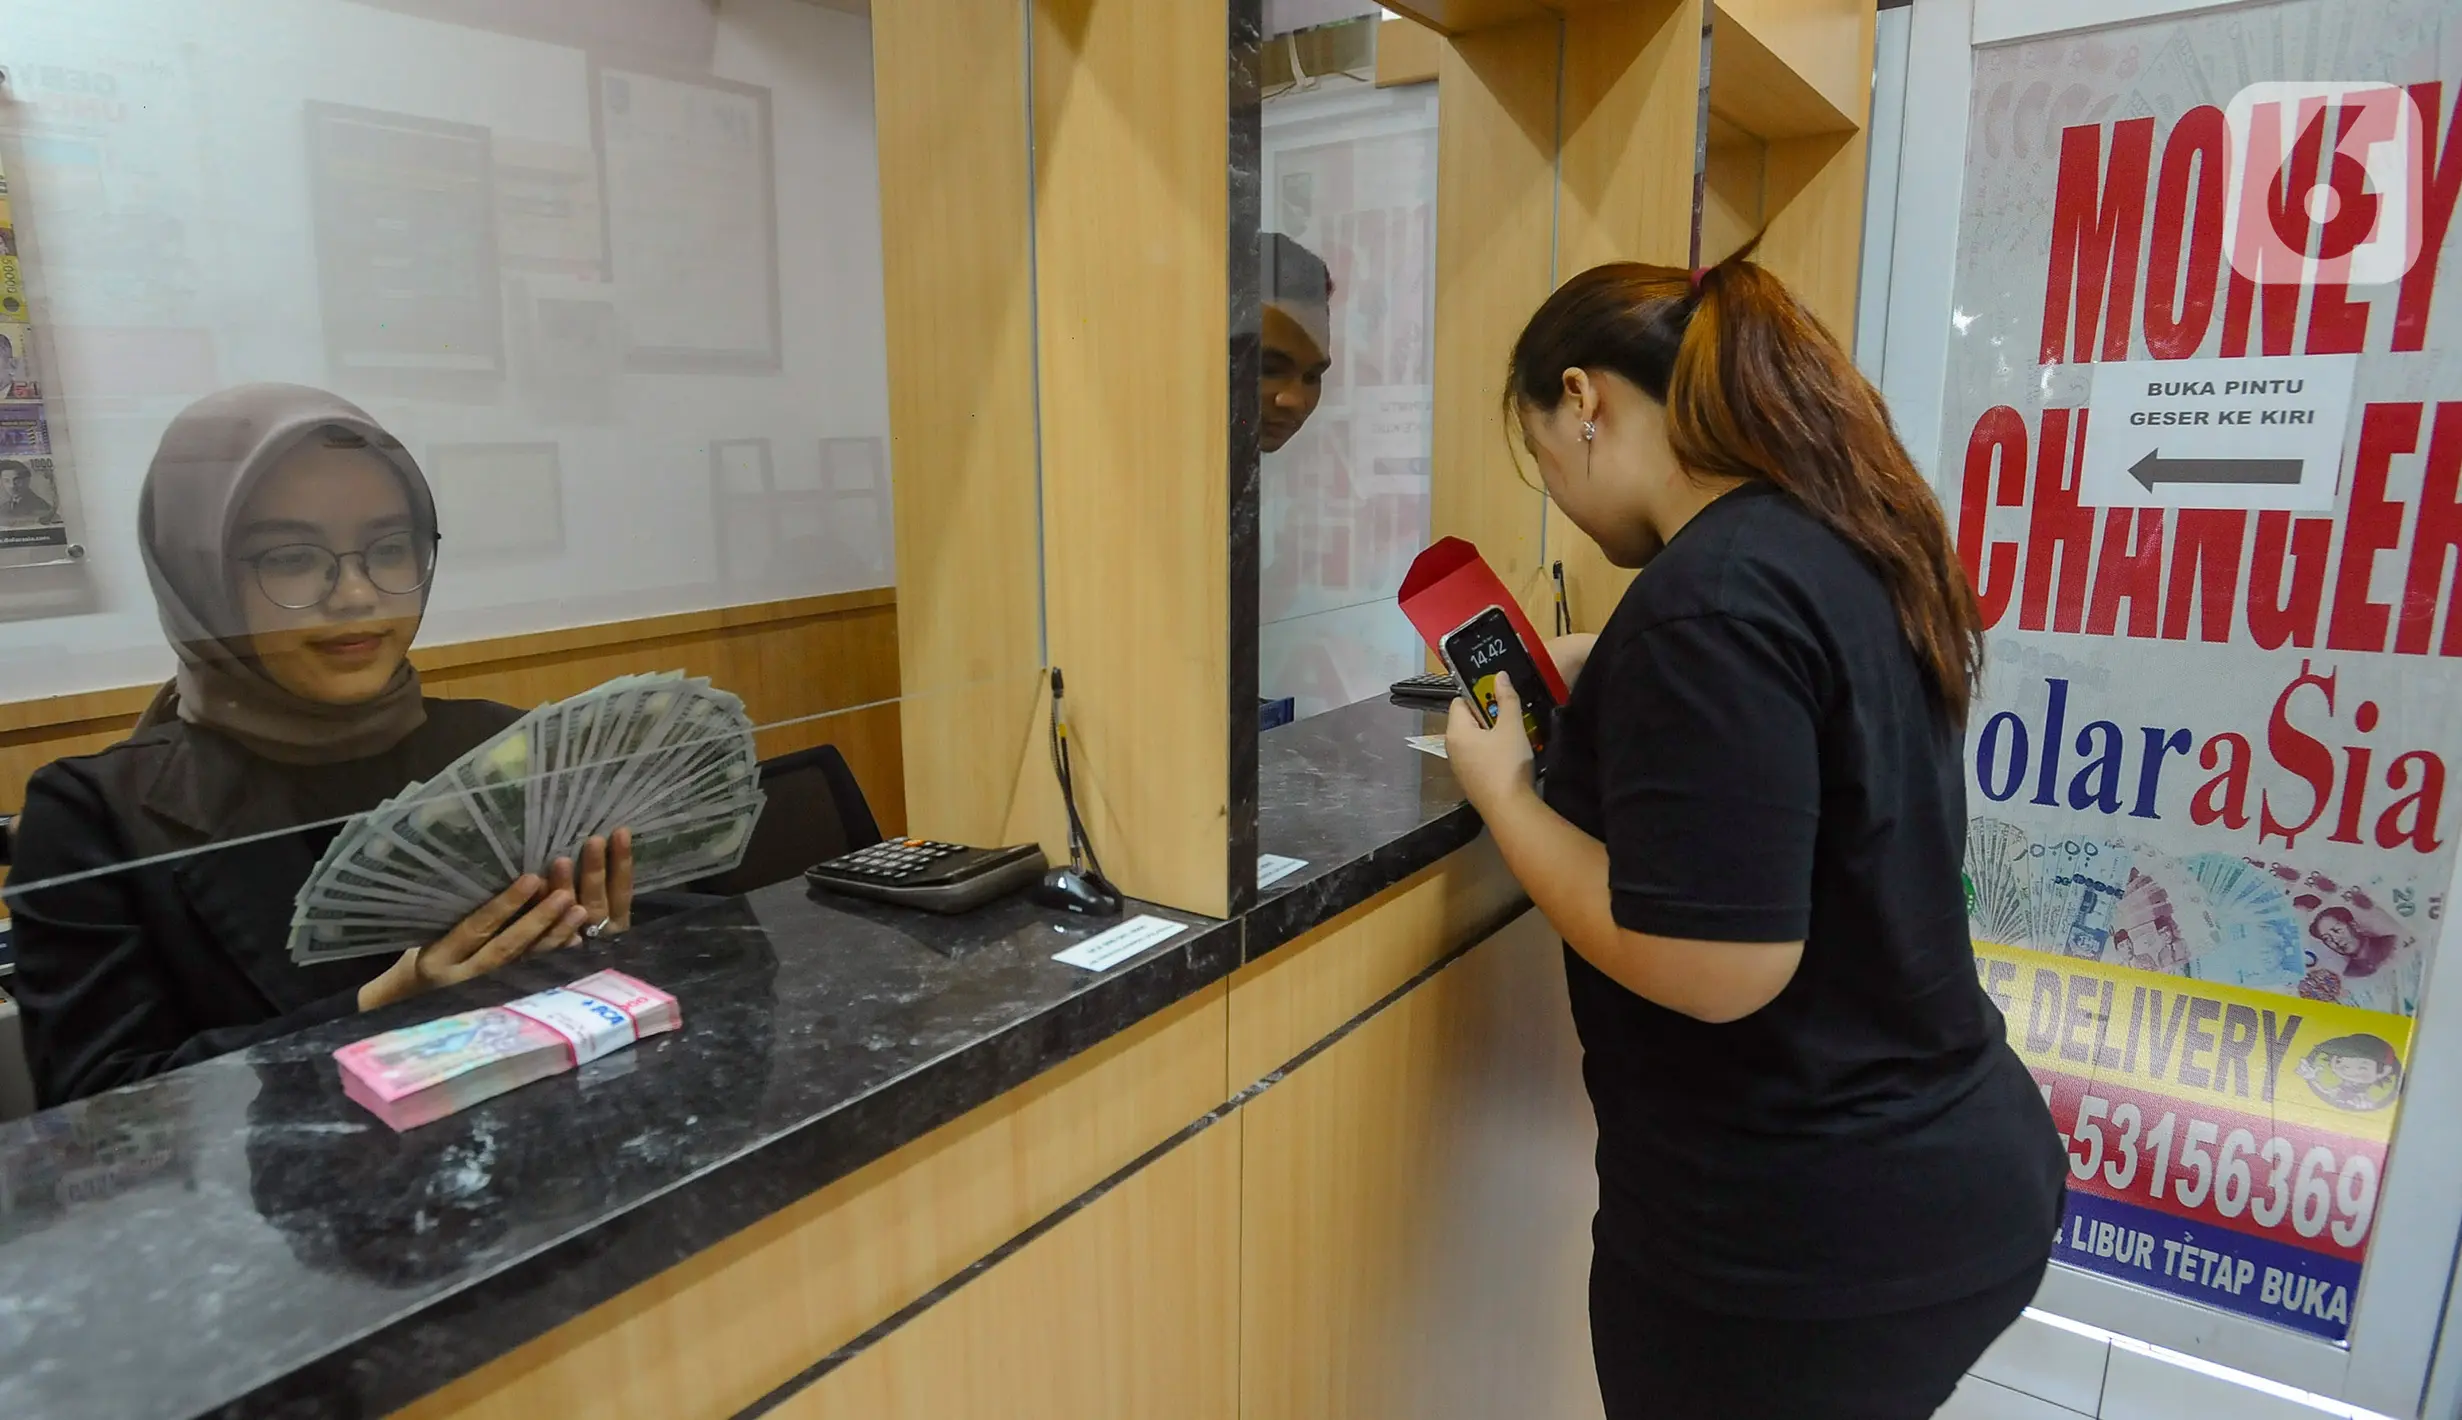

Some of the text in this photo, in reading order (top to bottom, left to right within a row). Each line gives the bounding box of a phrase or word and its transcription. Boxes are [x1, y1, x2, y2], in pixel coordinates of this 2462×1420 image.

[2038, 79, 2462, 364] MONEY
[2129, 409, 2315, 426] GESER KE KIRI
[2147, 379, 2304, 396] BUKA PINTU
[1470, 638, 1507, 668] 14.42
[2025, 968, 2302, 1103] DELIVERY
[2071, 1215, 2348, 1324] LIBUR TETAP BUKA
